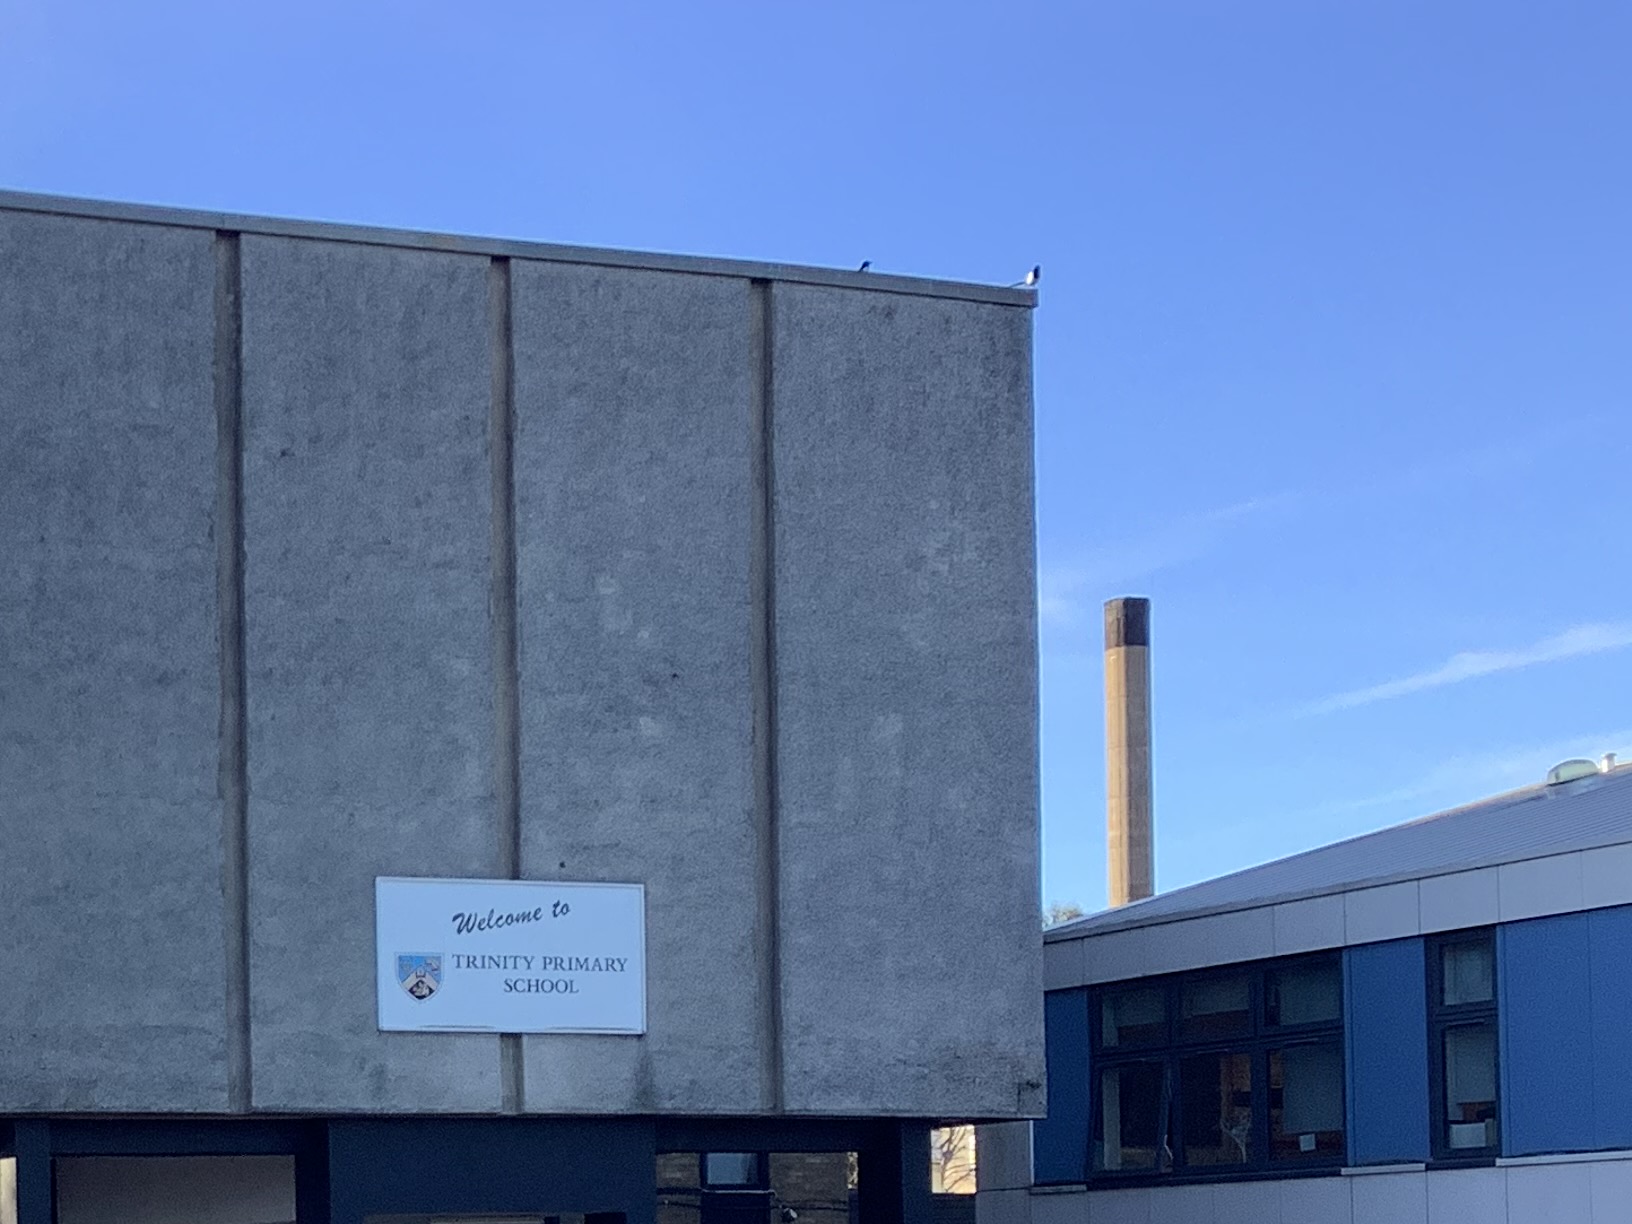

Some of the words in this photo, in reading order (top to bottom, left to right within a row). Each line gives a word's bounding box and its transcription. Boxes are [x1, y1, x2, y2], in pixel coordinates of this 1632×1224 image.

[452, 907, 542, 935] Welcome
[552, 899, 571, 917] to
[452, 954, 535, 970] TRINITY
[543, 956, 628, 972] PRIMARY
[504, 979, 579, 994] SCHOOL
